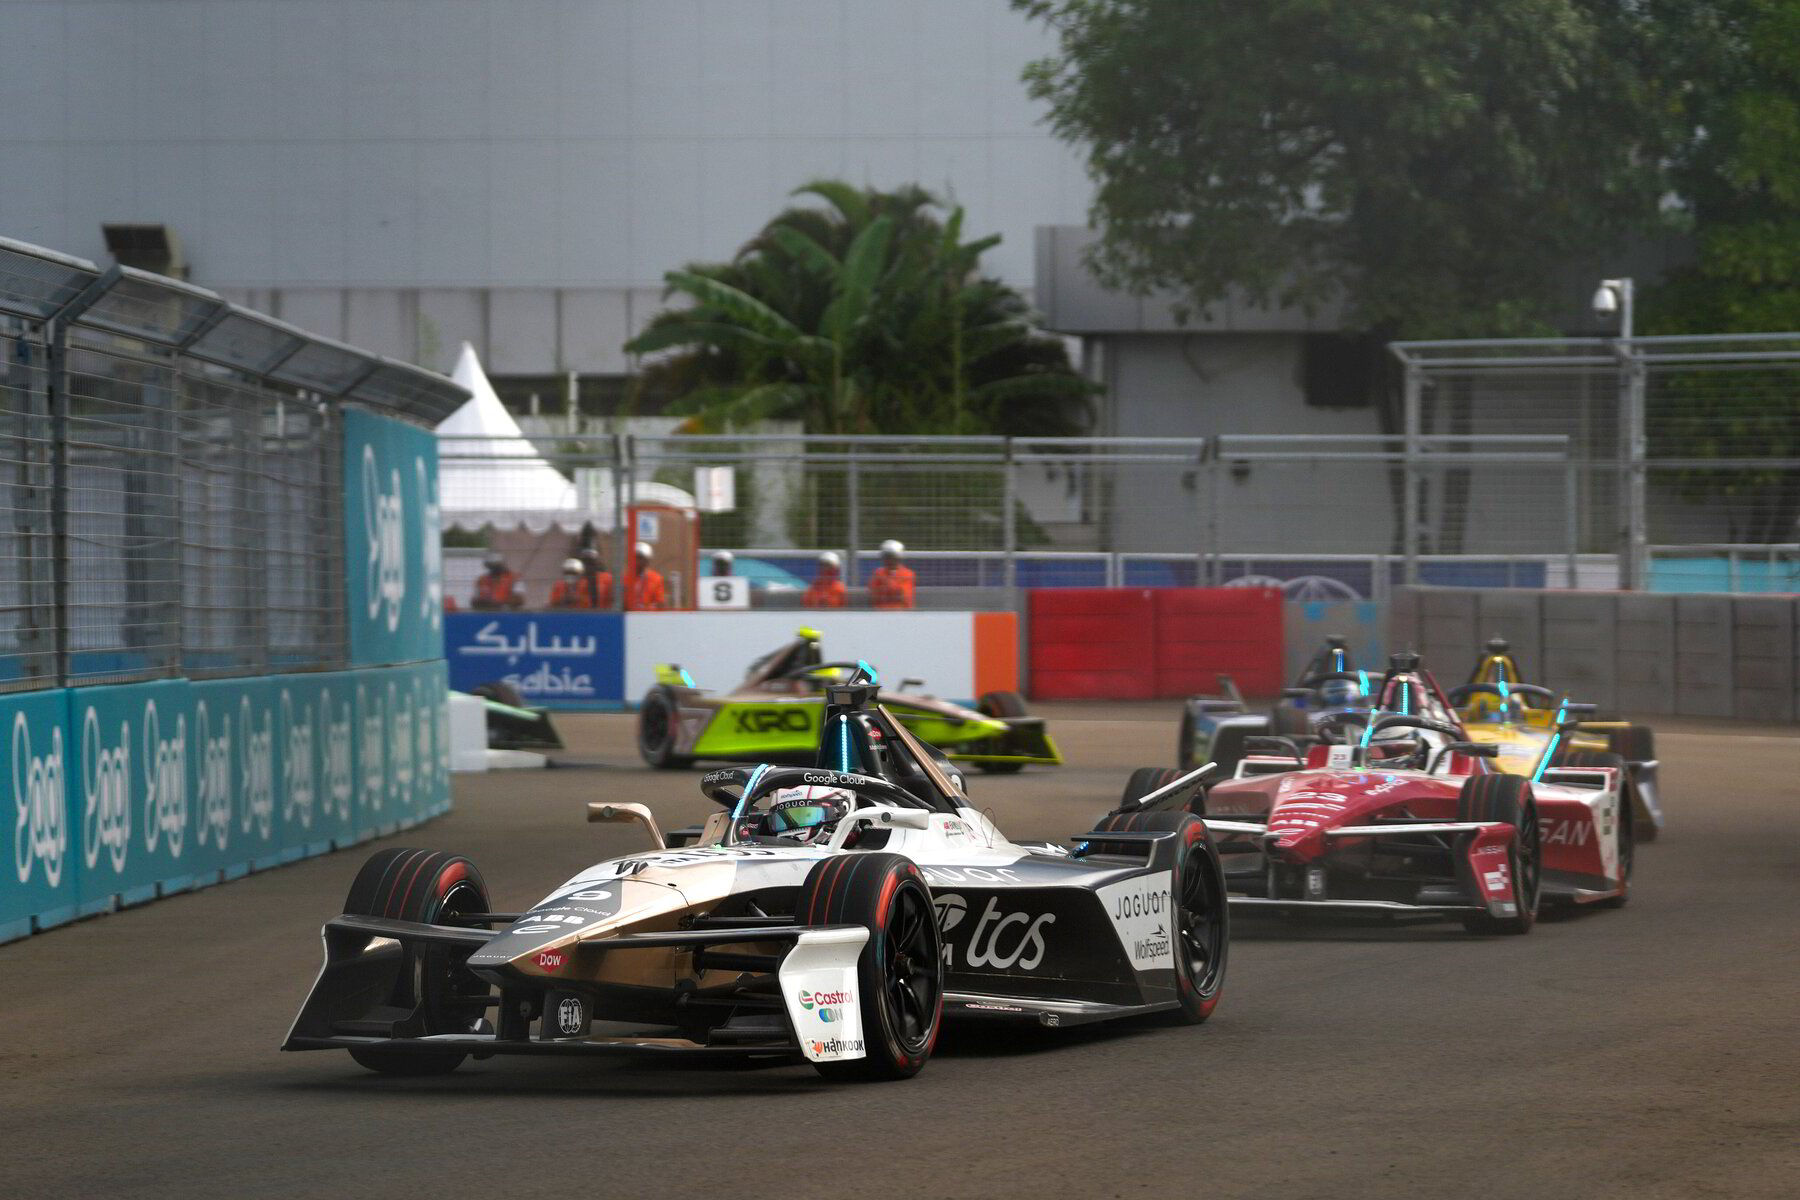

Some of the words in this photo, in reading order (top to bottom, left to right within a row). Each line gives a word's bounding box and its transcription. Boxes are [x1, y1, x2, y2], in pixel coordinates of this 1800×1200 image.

[719, 770, 735, 781] Cloud
[803, 772, 838, 786] Google
[839, 773, 866, 786] Cloud
[567, 890, 613, 901] 9
[517, 914, 585, 925] ABB
[965, 896, 1056, 971] tcs
[540, 953, 562, 966] Dow
[814, 989, 854, 1006] Castrol
